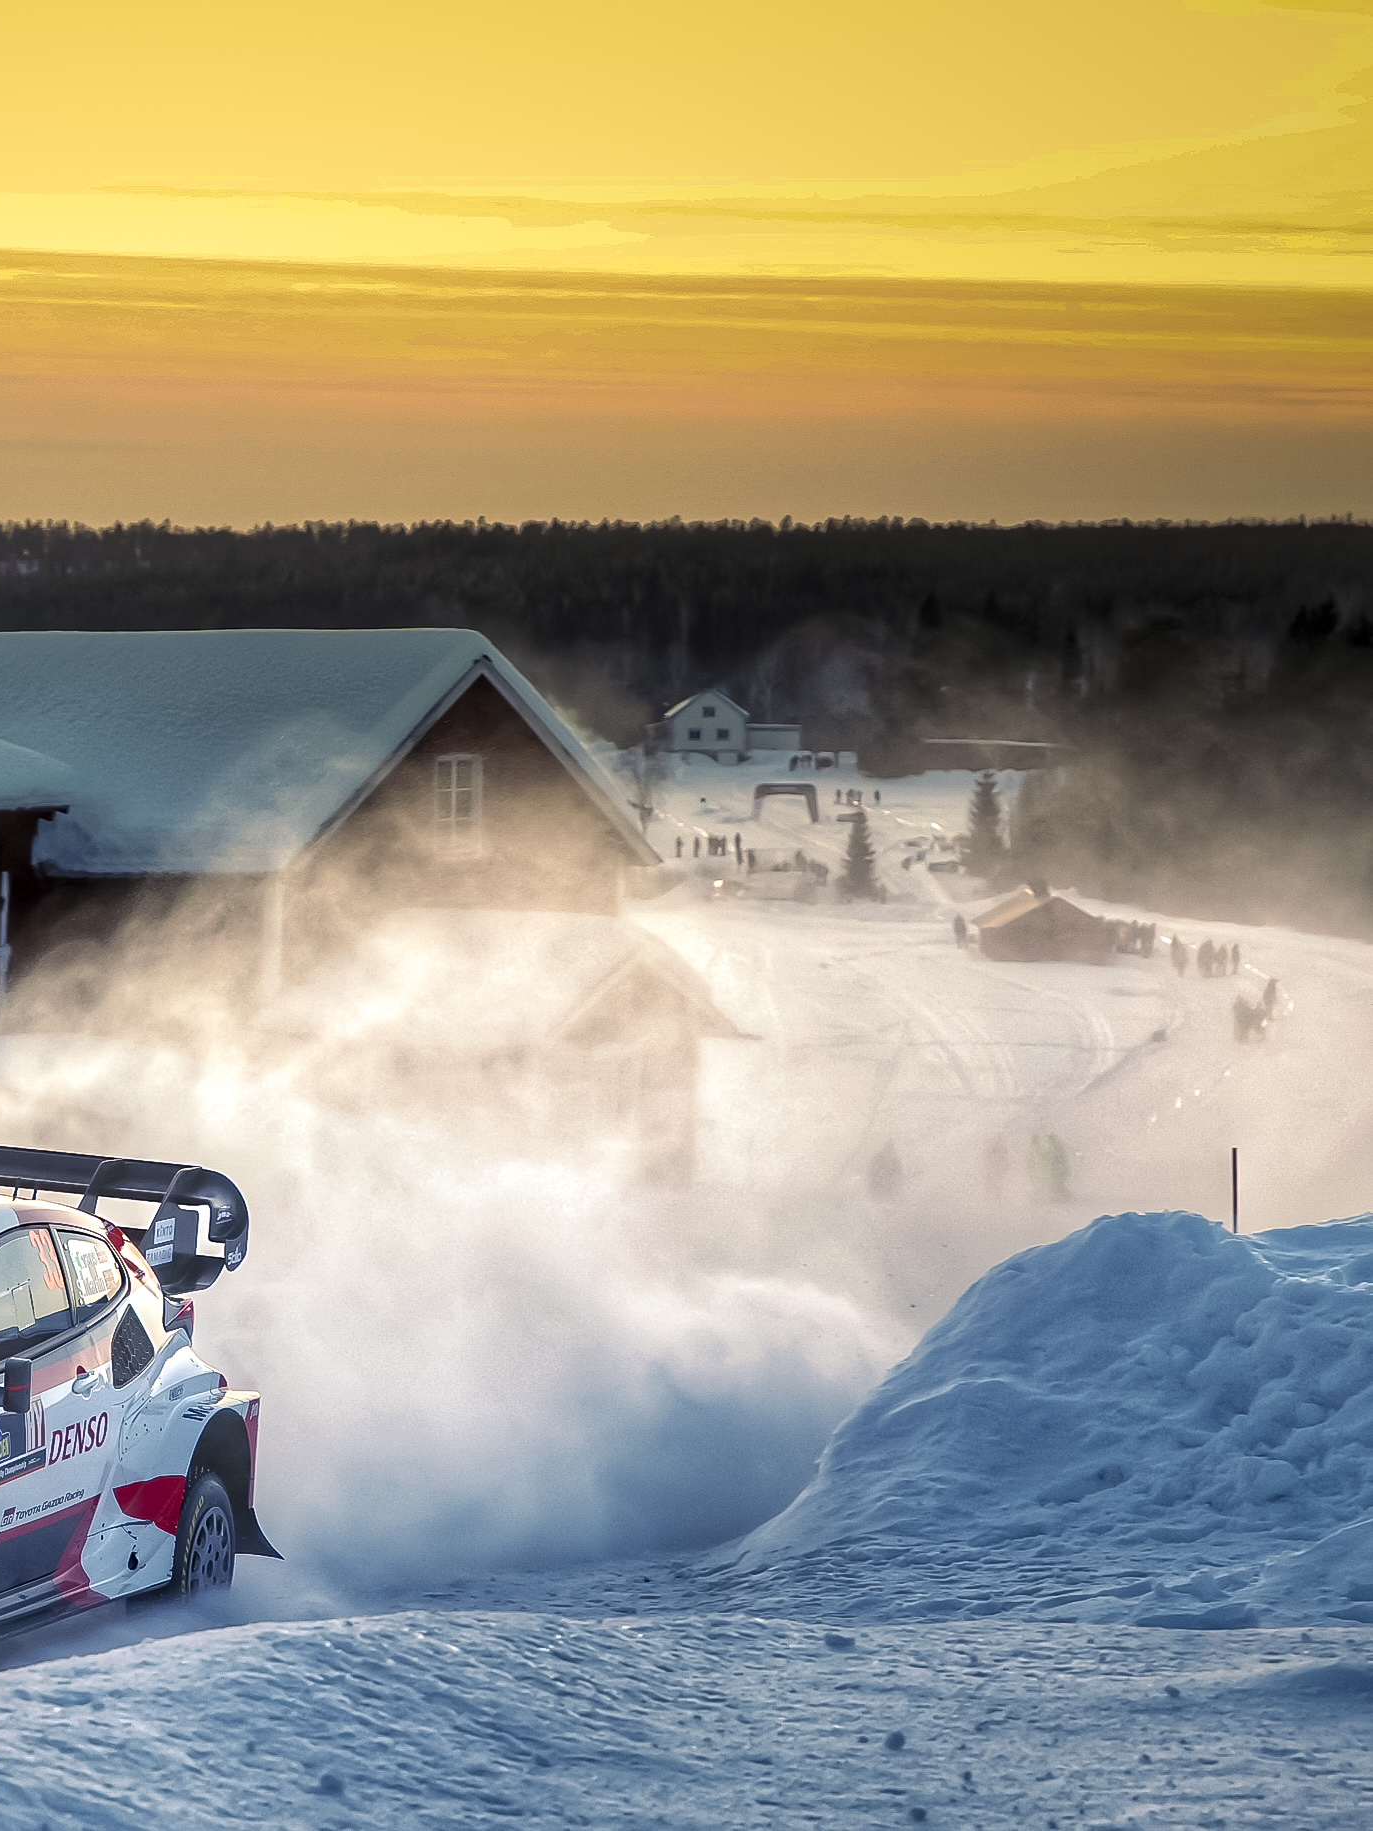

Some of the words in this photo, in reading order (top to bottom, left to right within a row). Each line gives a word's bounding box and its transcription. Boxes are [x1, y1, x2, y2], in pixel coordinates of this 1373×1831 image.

[48, 1411, 108, 1466] DENSO
[15, 1505, 42, 1521] TOYOTA
[41, 1496, 64, 1511] GAZOO
[64, 1489, 85, 1502] Racing
